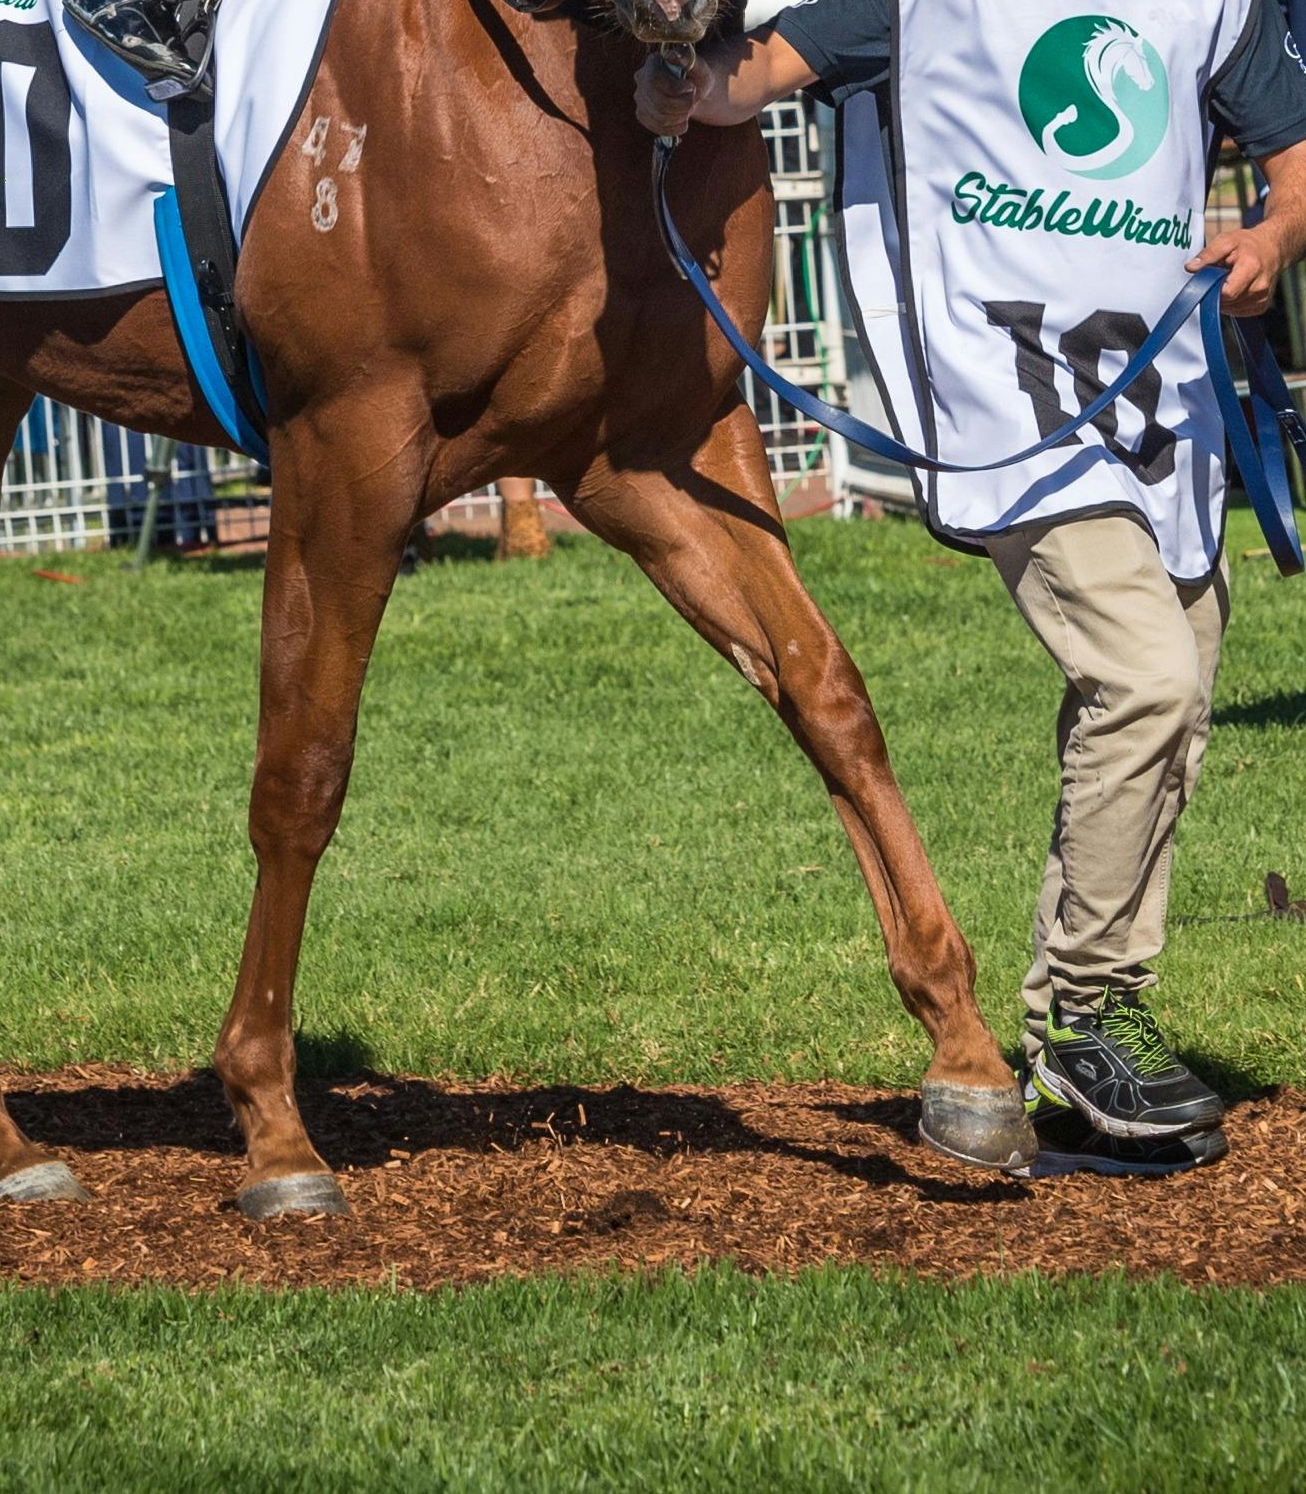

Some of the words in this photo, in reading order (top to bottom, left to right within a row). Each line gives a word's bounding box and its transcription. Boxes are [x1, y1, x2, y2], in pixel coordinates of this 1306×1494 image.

[311, 177, 339, 233] 8
[951, 170, 1193, 251] StableWizard
[981, 300, 1177, 486] 10
